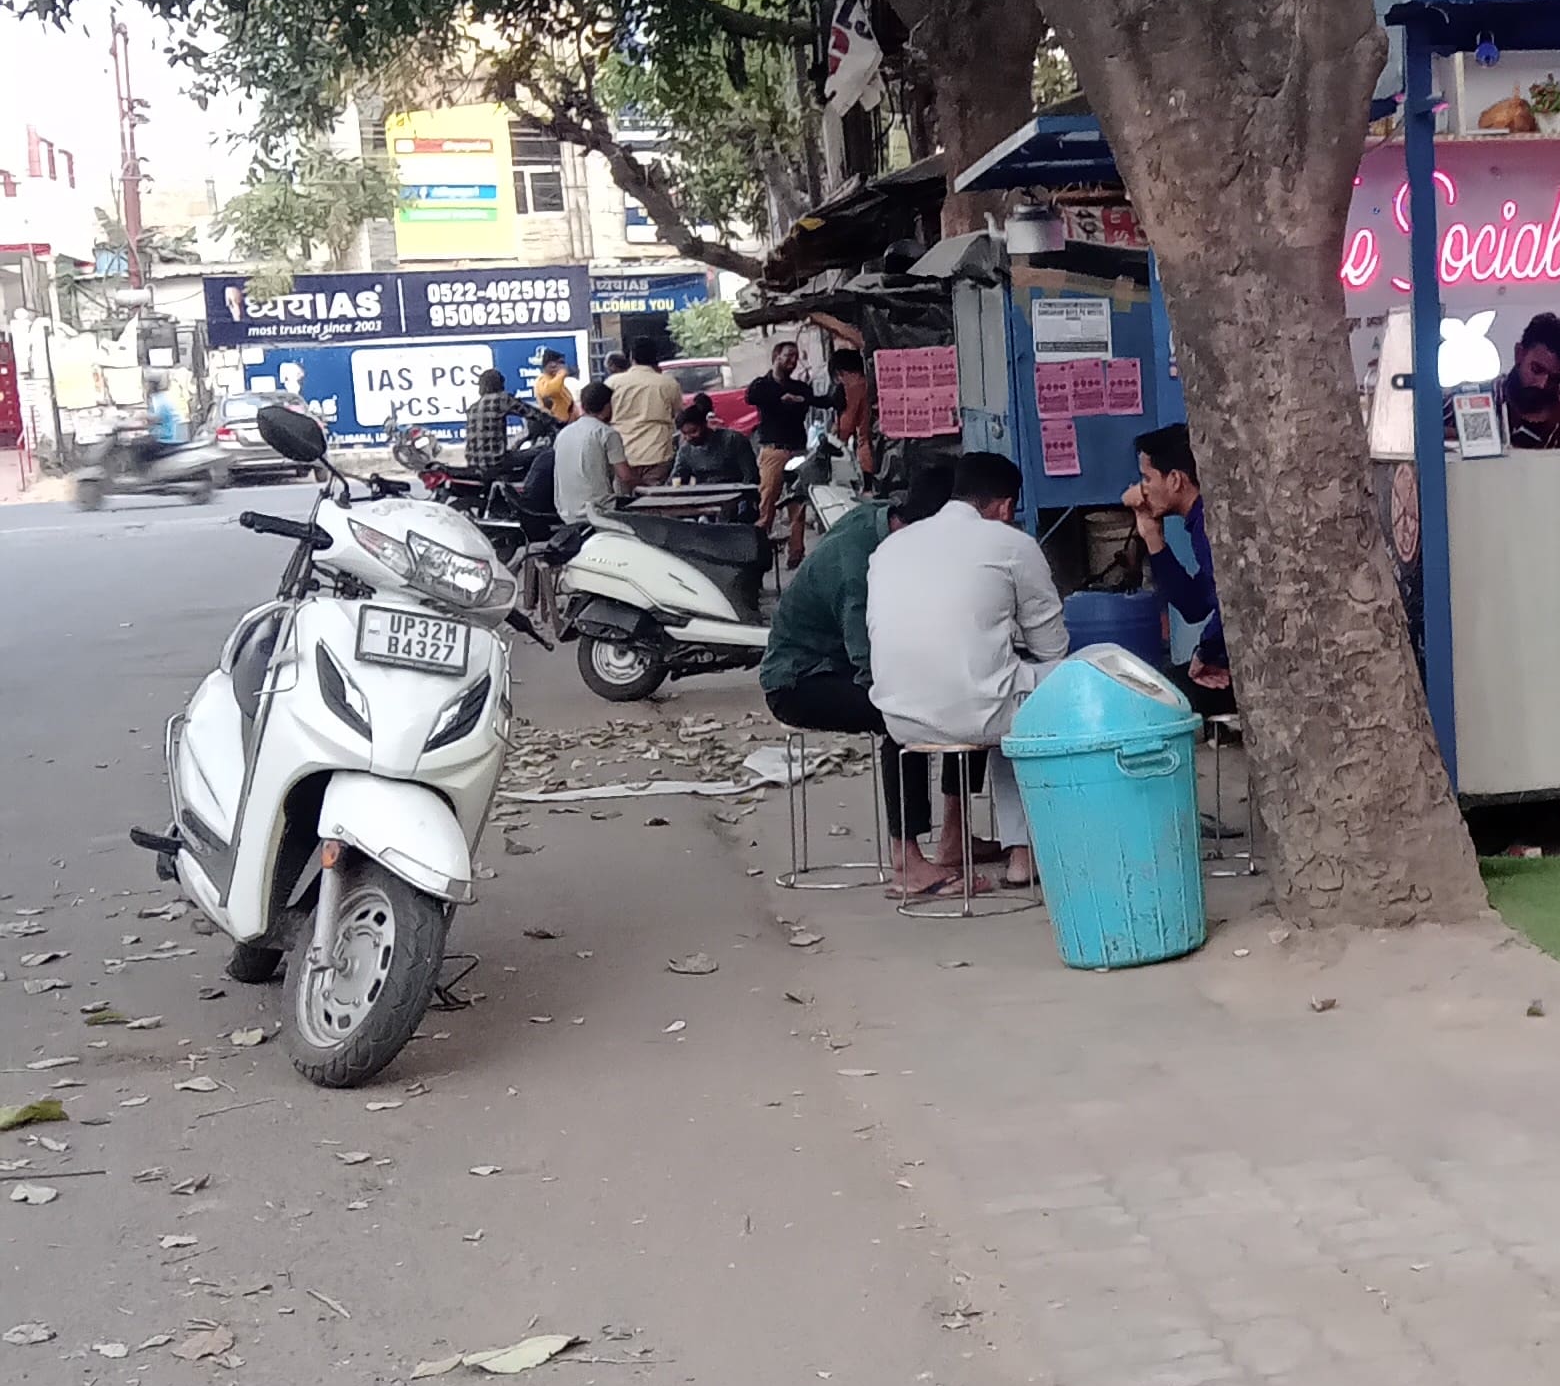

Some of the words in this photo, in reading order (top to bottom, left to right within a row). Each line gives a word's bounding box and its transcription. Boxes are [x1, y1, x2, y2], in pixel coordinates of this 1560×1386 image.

[429, 300, 571, 327] 9506256789
[590, 298, 646, 313] ELCOMES
[648, 298, 674, 311] YOU
[248, 324, 276, 336] most
[279, 322, 320, 337] trusted
[323, 322, 352, 335] since
[354, 320, 382, 332] 2003
[367, 368, 413, 391] IAS
[431, 365, 484, 387] PCS
[390, 396, 468, 418] PCS-J
[389, 614, 457, 644] UP32H
[387, 636, 455, 662] B4327
